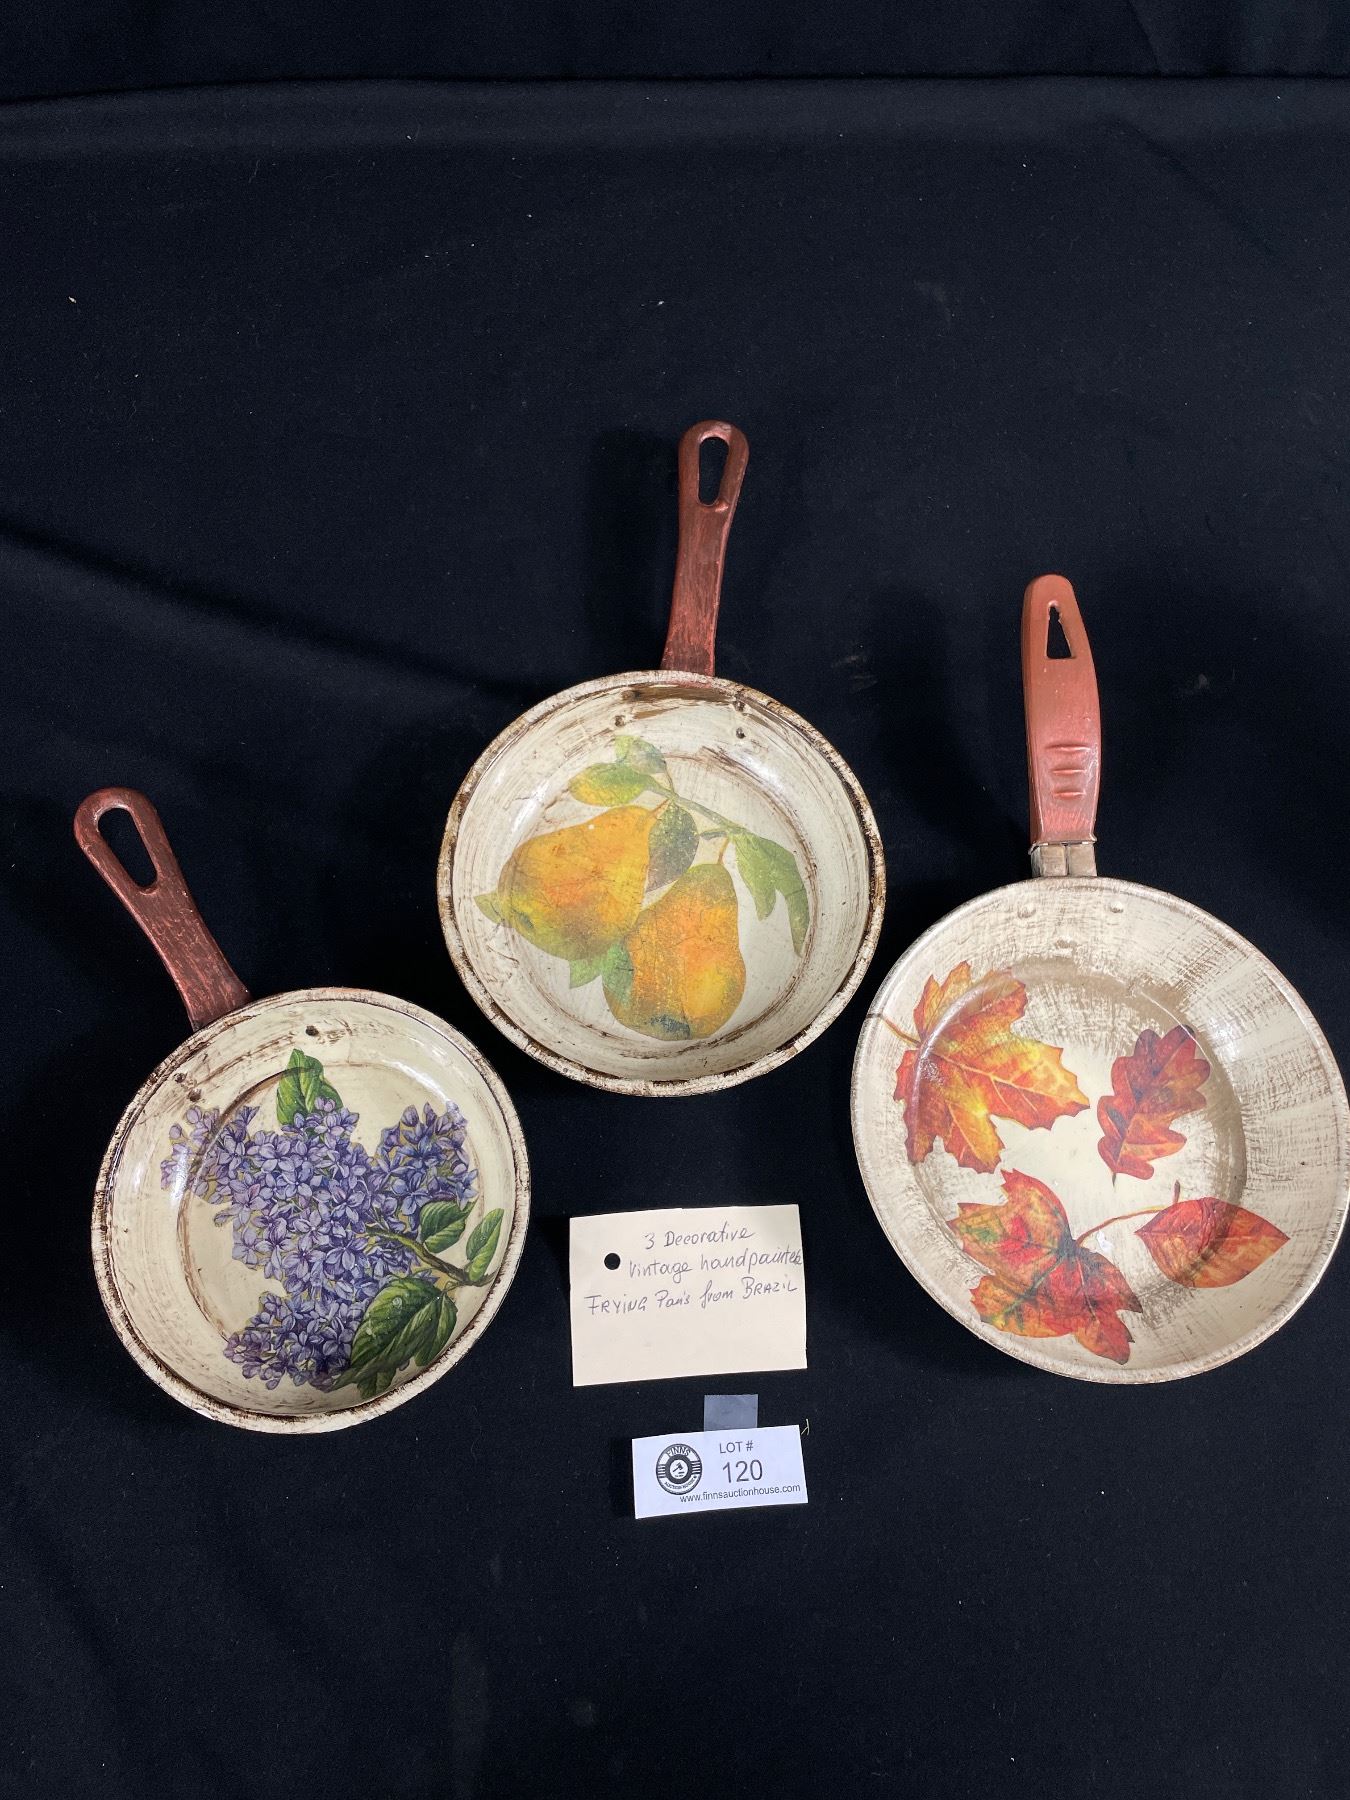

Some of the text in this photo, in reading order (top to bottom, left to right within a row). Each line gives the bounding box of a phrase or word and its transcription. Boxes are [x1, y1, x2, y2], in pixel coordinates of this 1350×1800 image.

[645, 1221, 753, 1250] 3 Decorative
[700, 1280, 733, 1308] from
[719, 1442, 743, 1454] LOT
[722, 1459, 763, 1484] 120
[680, 1484, 801, 1503] www.finnsauctionhouse.com
